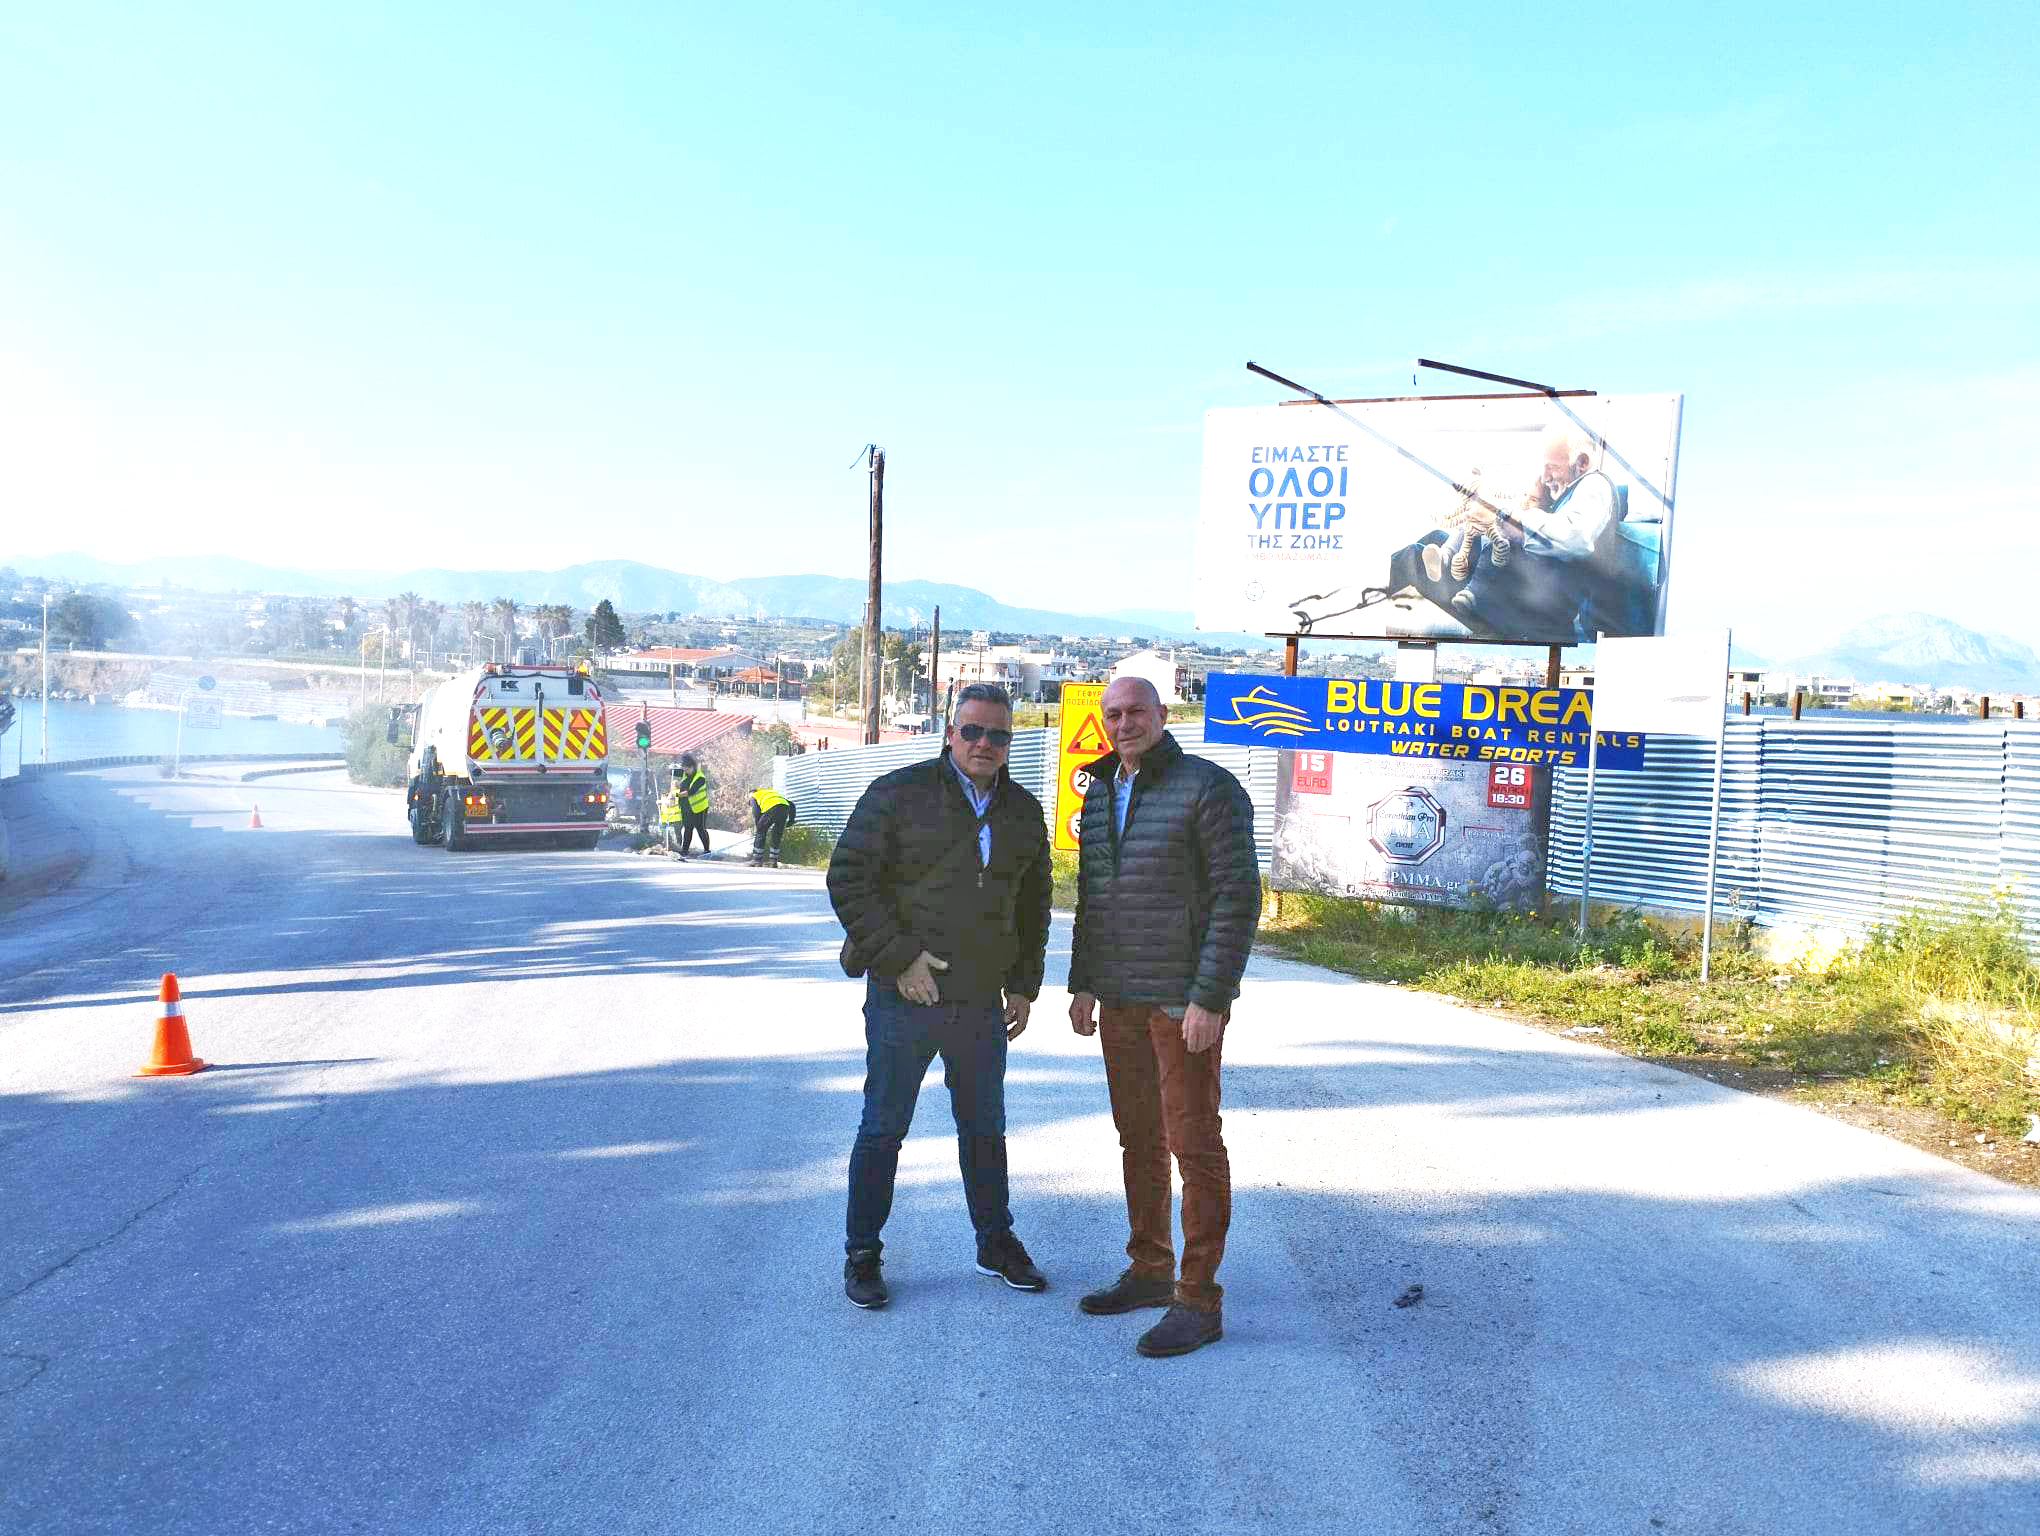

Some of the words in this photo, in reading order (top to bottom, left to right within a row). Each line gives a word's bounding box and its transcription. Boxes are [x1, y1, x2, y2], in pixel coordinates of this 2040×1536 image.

[1251, 444, 1349, 463] ΕΙΜΑΣΤΕ
[1248, 466, 1348, 498] ΟΛΟΙ
[1248, 502, 1346, 530] ΥΠΕΡ
[1247, 534, 1283, 549] ΤΗΣ
[1290, 534, 1343, 549] ΖΩΗΣ
[1077, 690, 1104, 698] ΓΕΦΥΡ
[1326, 680, 1442, 718] BLUE
[1461, 686, 1593, 726] DREA
[1325, 719, 1435, 736] LOUTRAKI
[1451, 725, 1512, 741] BOAT
[1527, 729, 1640, 748] RENTALS
[1391, 740, 1470, 757] WATER
[1478, 745, 1577, 765] SPORTS
[1300, 753, 1325, 772] 15
[1297, 776, 1328, 789] EURO
[1494, 766, 1526, 785] 26
[1492, 793, 1525, 805] 18:30
